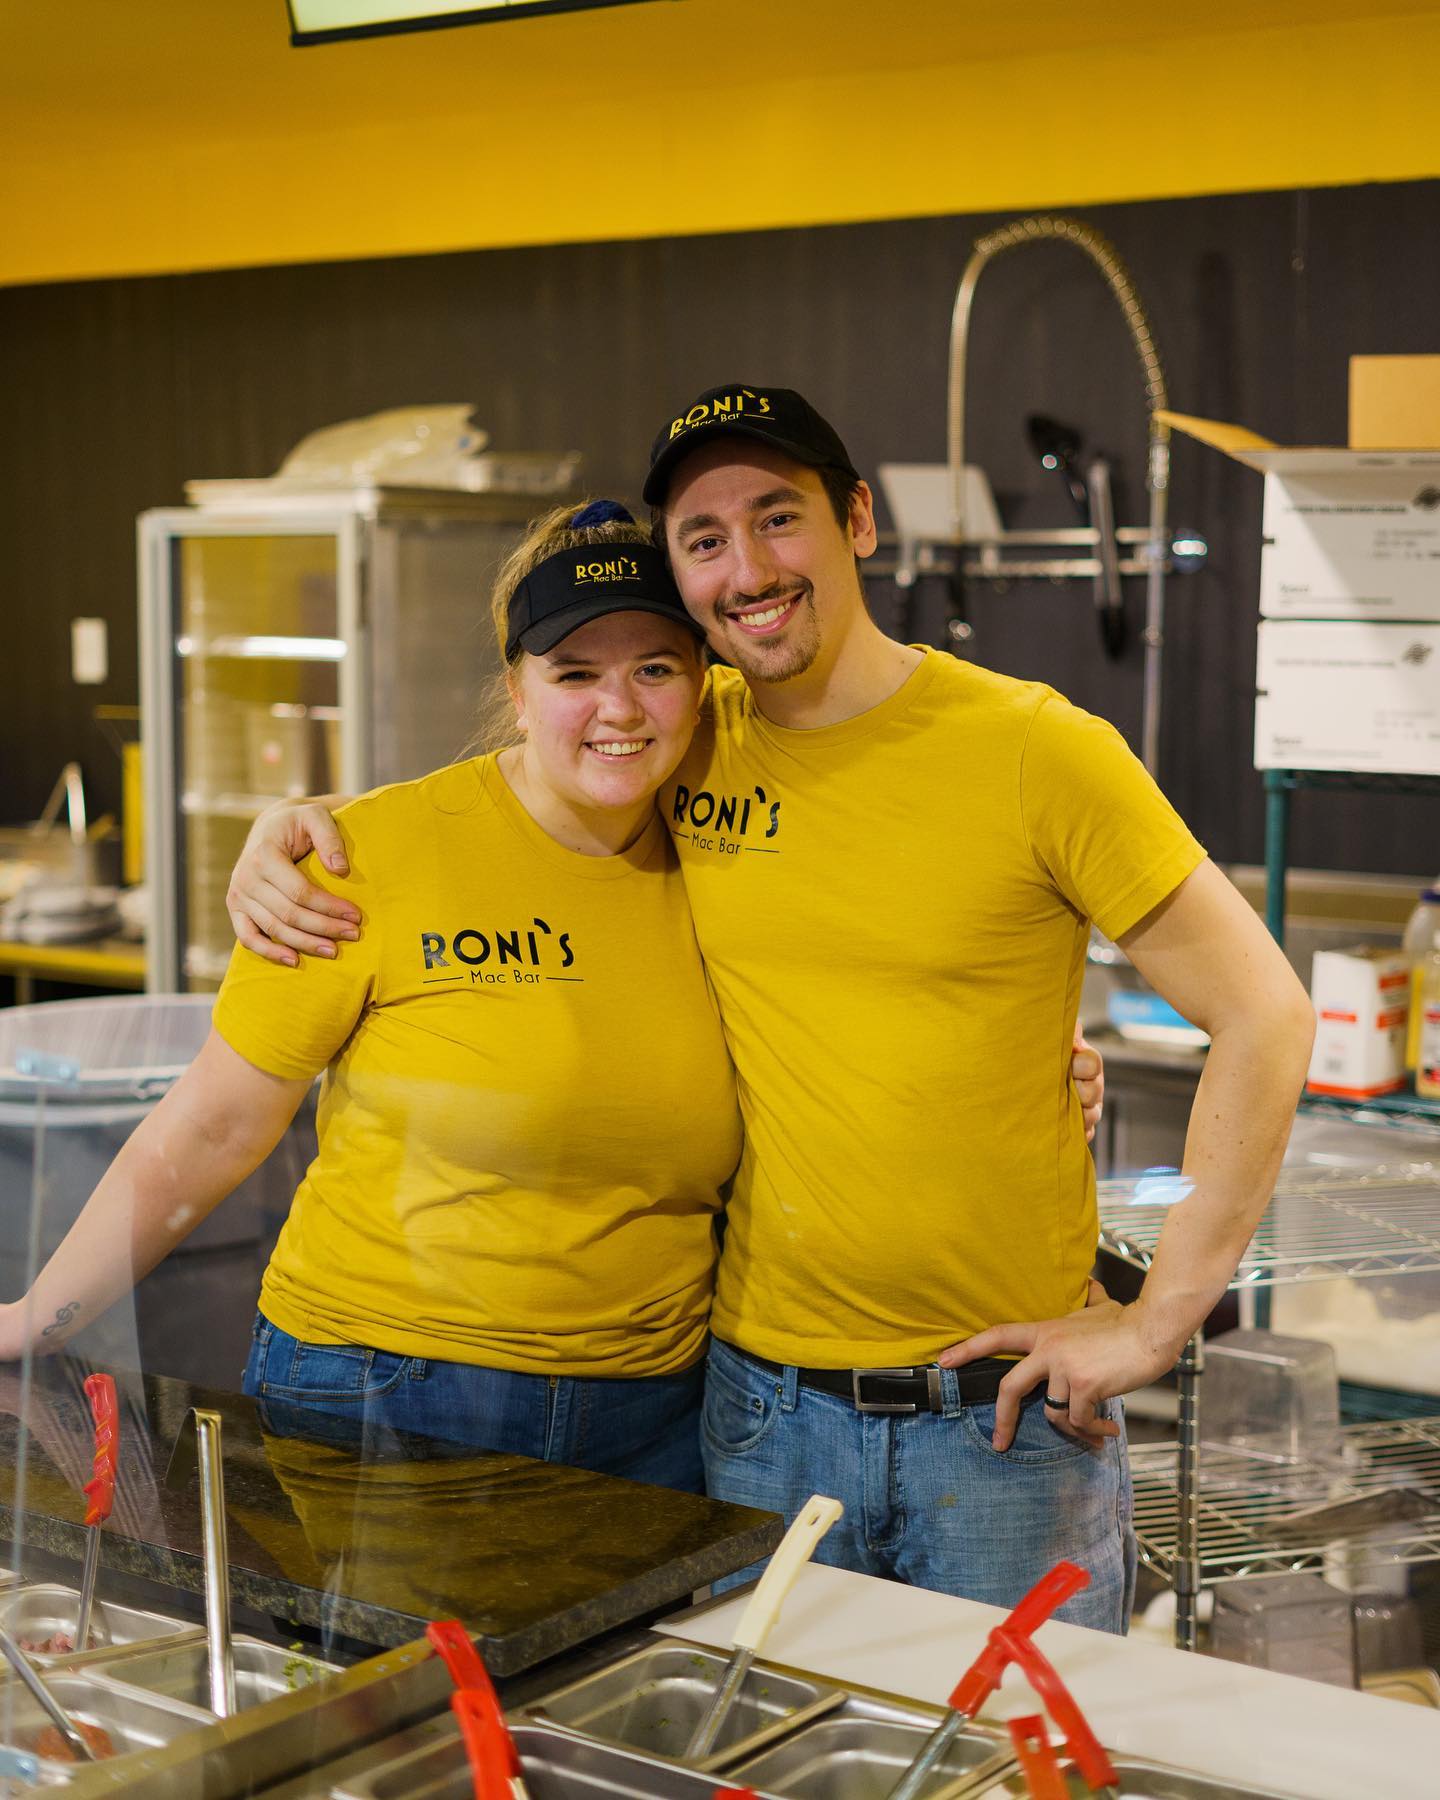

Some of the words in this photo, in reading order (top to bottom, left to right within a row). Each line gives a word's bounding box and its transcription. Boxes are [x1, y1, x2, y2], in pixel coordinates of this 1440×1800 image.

[669, 390, 770, 440] RONI'S
[720, 412, 741, 423] Bar
[576, 557, 637, 579] RONI'S
[673, 785, 780, 838] RONI'S
[691, 831, 714, 851] Mac
[718, 837, 741, 855] Bar
[421, 918, 574, 969] RONI'S
[470, 969, 507, 984] Mac
[513, 969, 540, 984] Bar
